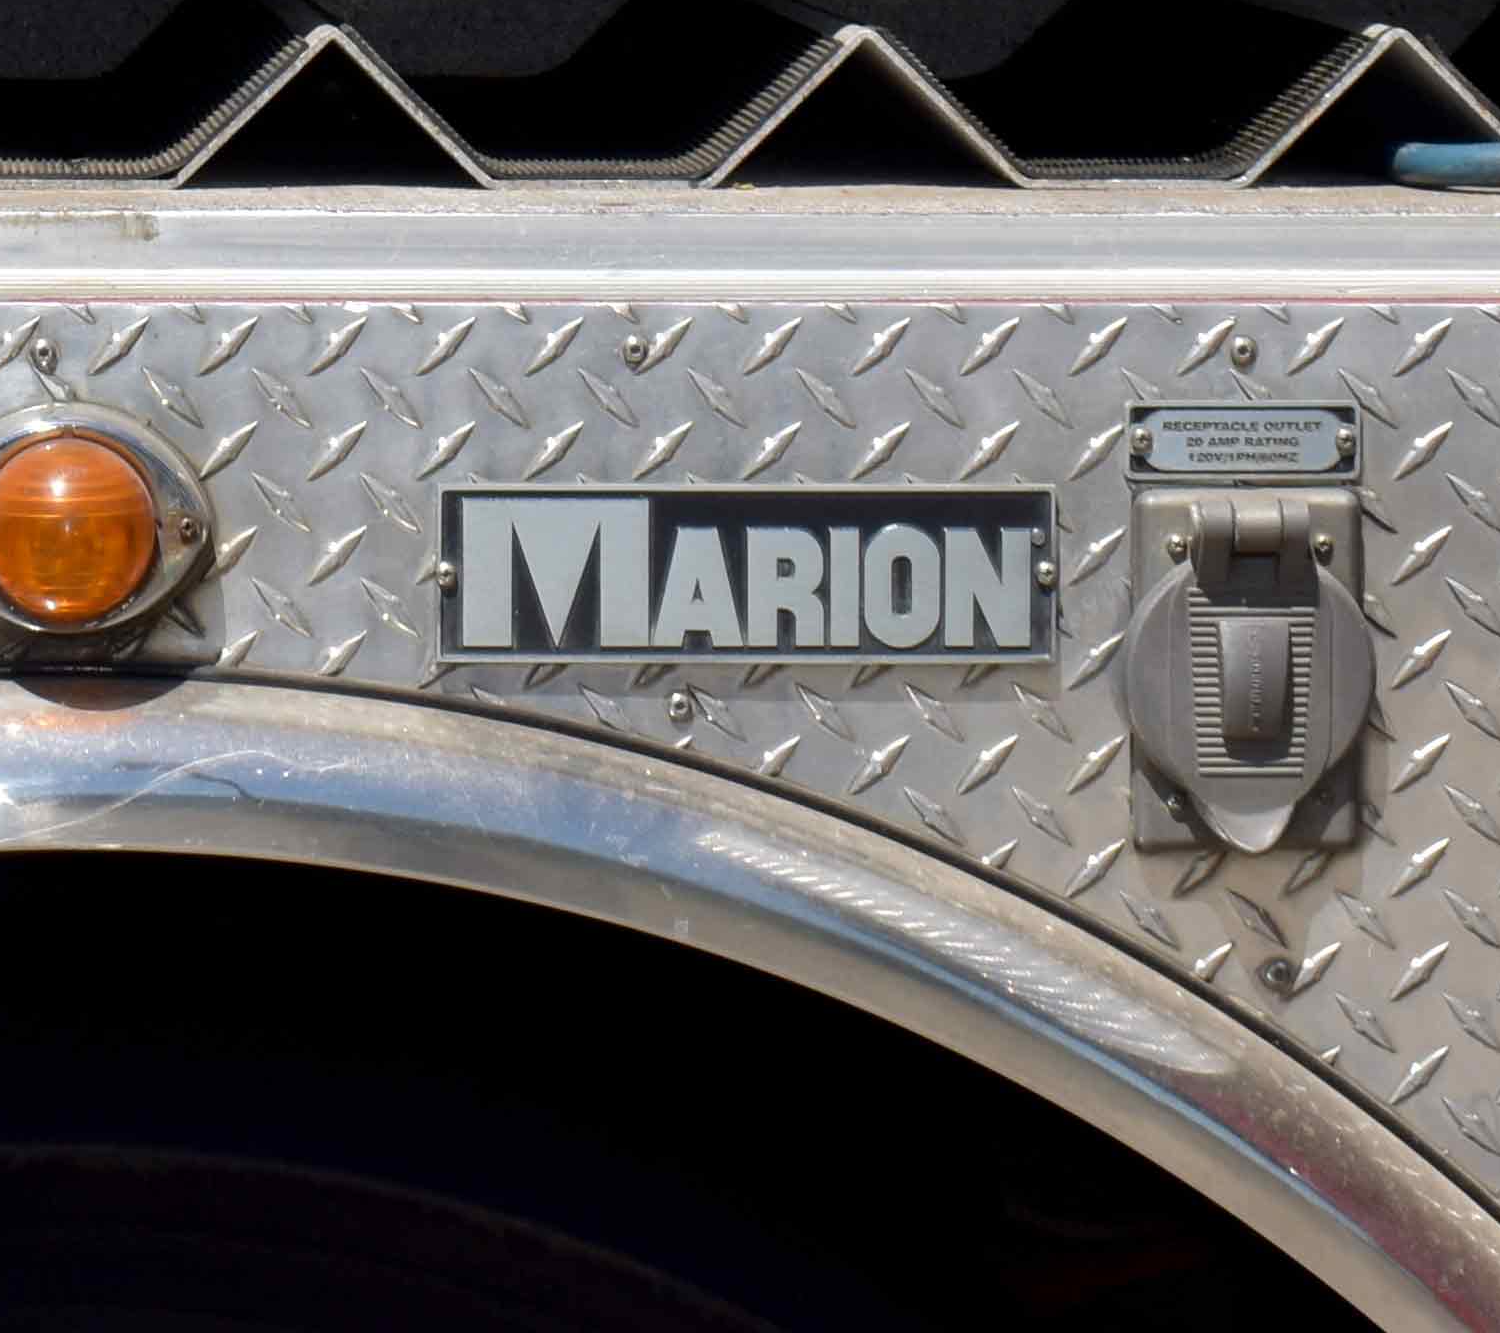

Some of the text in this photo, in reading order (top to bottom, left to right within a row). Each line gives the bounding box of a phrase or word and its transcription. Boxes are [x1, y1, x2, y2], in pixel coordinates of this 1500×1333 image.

[1161, 420, 1323, 432] RECEPTACLE OUTLET
[1185, 436, 1300, 447] 20 AMP RATING
[461, 496, 1033, 650] MARION
